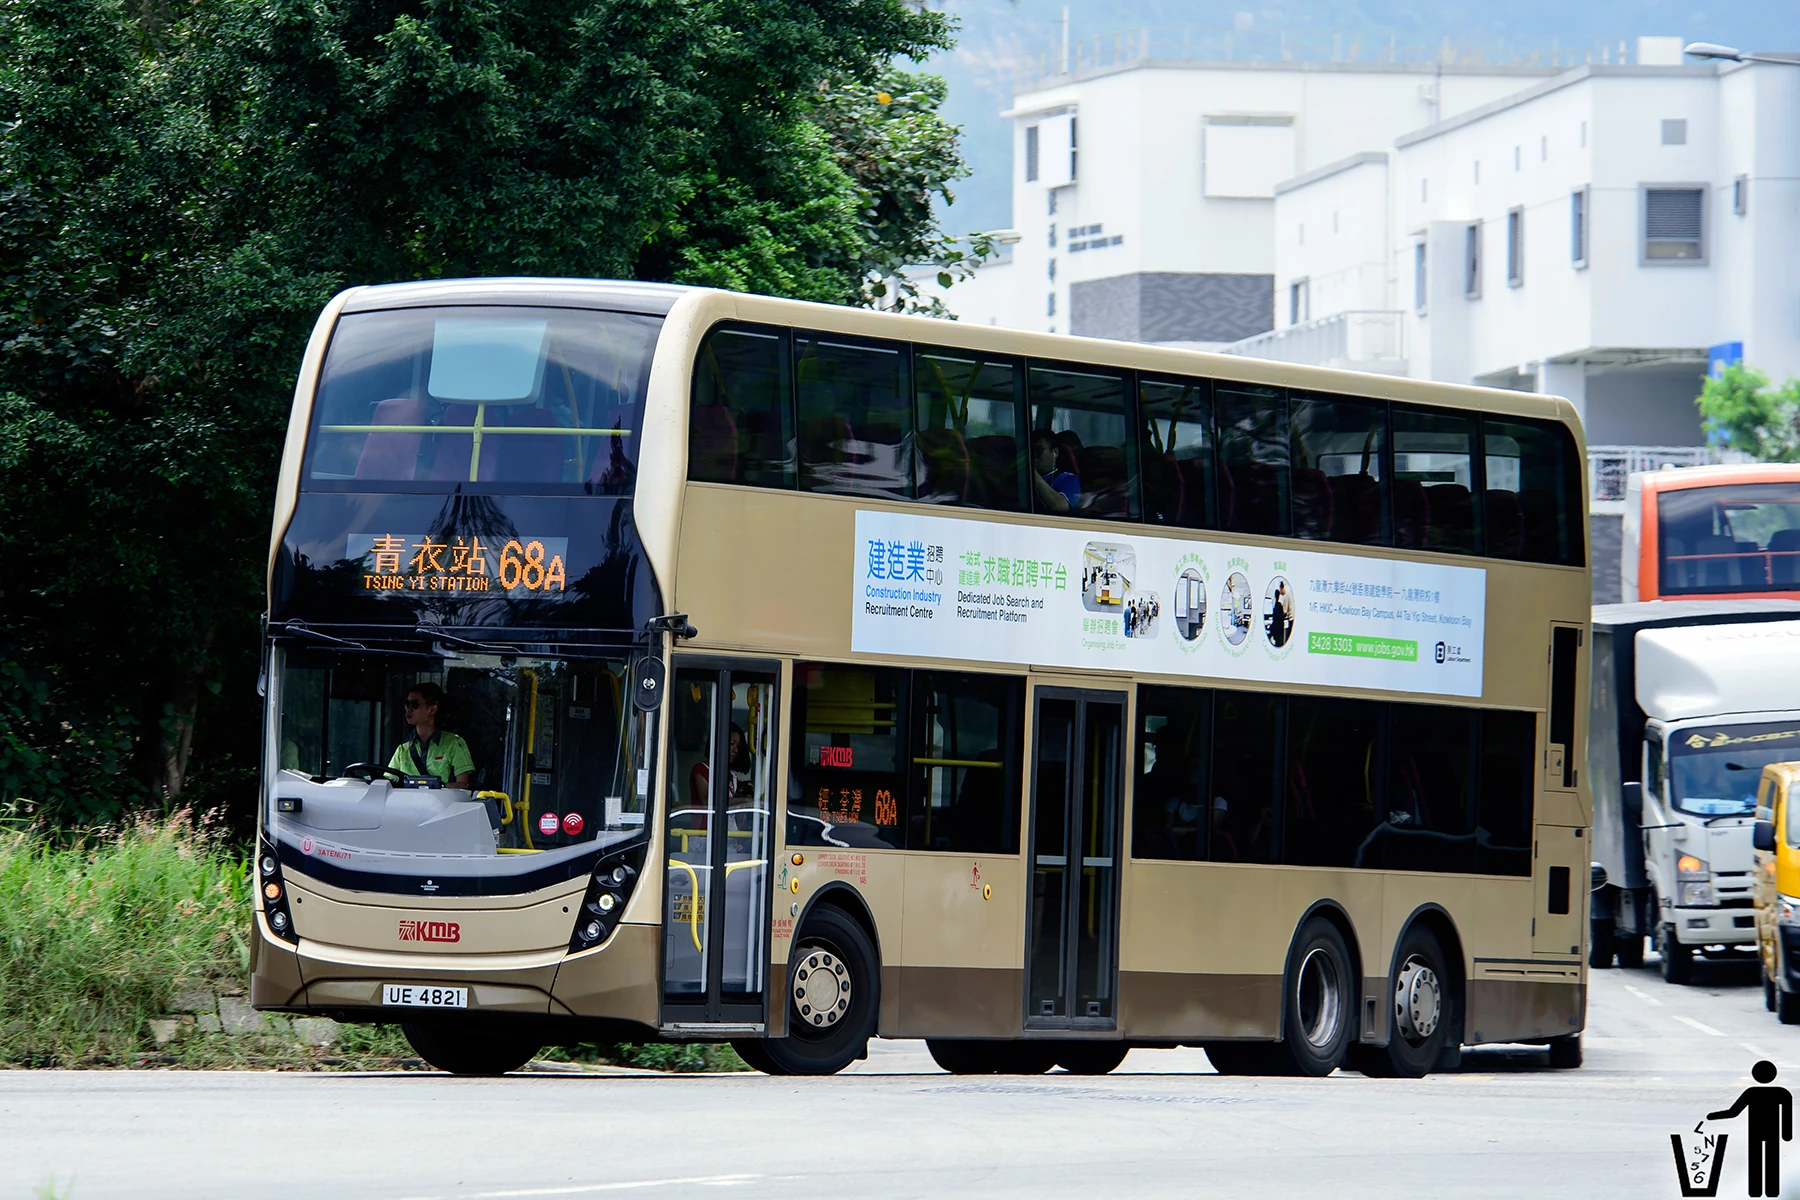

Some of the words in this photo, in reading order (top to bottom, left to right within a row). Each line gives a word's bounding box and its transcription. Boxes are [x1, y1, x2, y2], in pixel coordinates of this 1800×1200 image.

[370, 533, 488, 575] 青衣站
[866, 538, 925, 582] 建造業
[926, 544, 944, 563] 招聘
[959, 550, 981, 566] 一站式
[499, 540, 566, 591] 68A
[926, 567, 944, 585] 中心
[983, 556, 1067, 590] 求職招聘平台
[364, 575, 404, 590] TSING
[409, 576, 425, 590] YI
[429, 576, 489, 591] STATION
[958, 569, 981, 586] 建造業
[865, 584, 911, 600] Construction
[912, 588, 942, 606] Industry
[957, 590, 991, 605] Dedicated
[992, 593, 1005, 606] Job
[1006, 595, 1030, 608] Search
[1030, 597, 1044, 609] and
[865, 601, 908, 617] Recruitment
[909, 605, 934, 619] Centre
[957, 605, 998, 621] Recruitment
[999, 609, 1028, 623] Platform
[1338, 606, 1361, 617] Kowloon
[1361, 607, 1372, 620] Bay
[1438, 615, 1461, 626] Kowloon
[1462, 616, 1472, 628] Bay
[1310, 636, 1331, 650] 3428
[1333, 637, 1353, 652] 3303
[1355, 639, 1416, 658] www.jobs.gov.hk
[829, 746, 853, 768] KMB
[875, 789, 897, 826] 68A
[415, 920, 461, 943] KMB
[389, 987, 413, 1004] UE
[419, 988, 461, 1006] 4821
